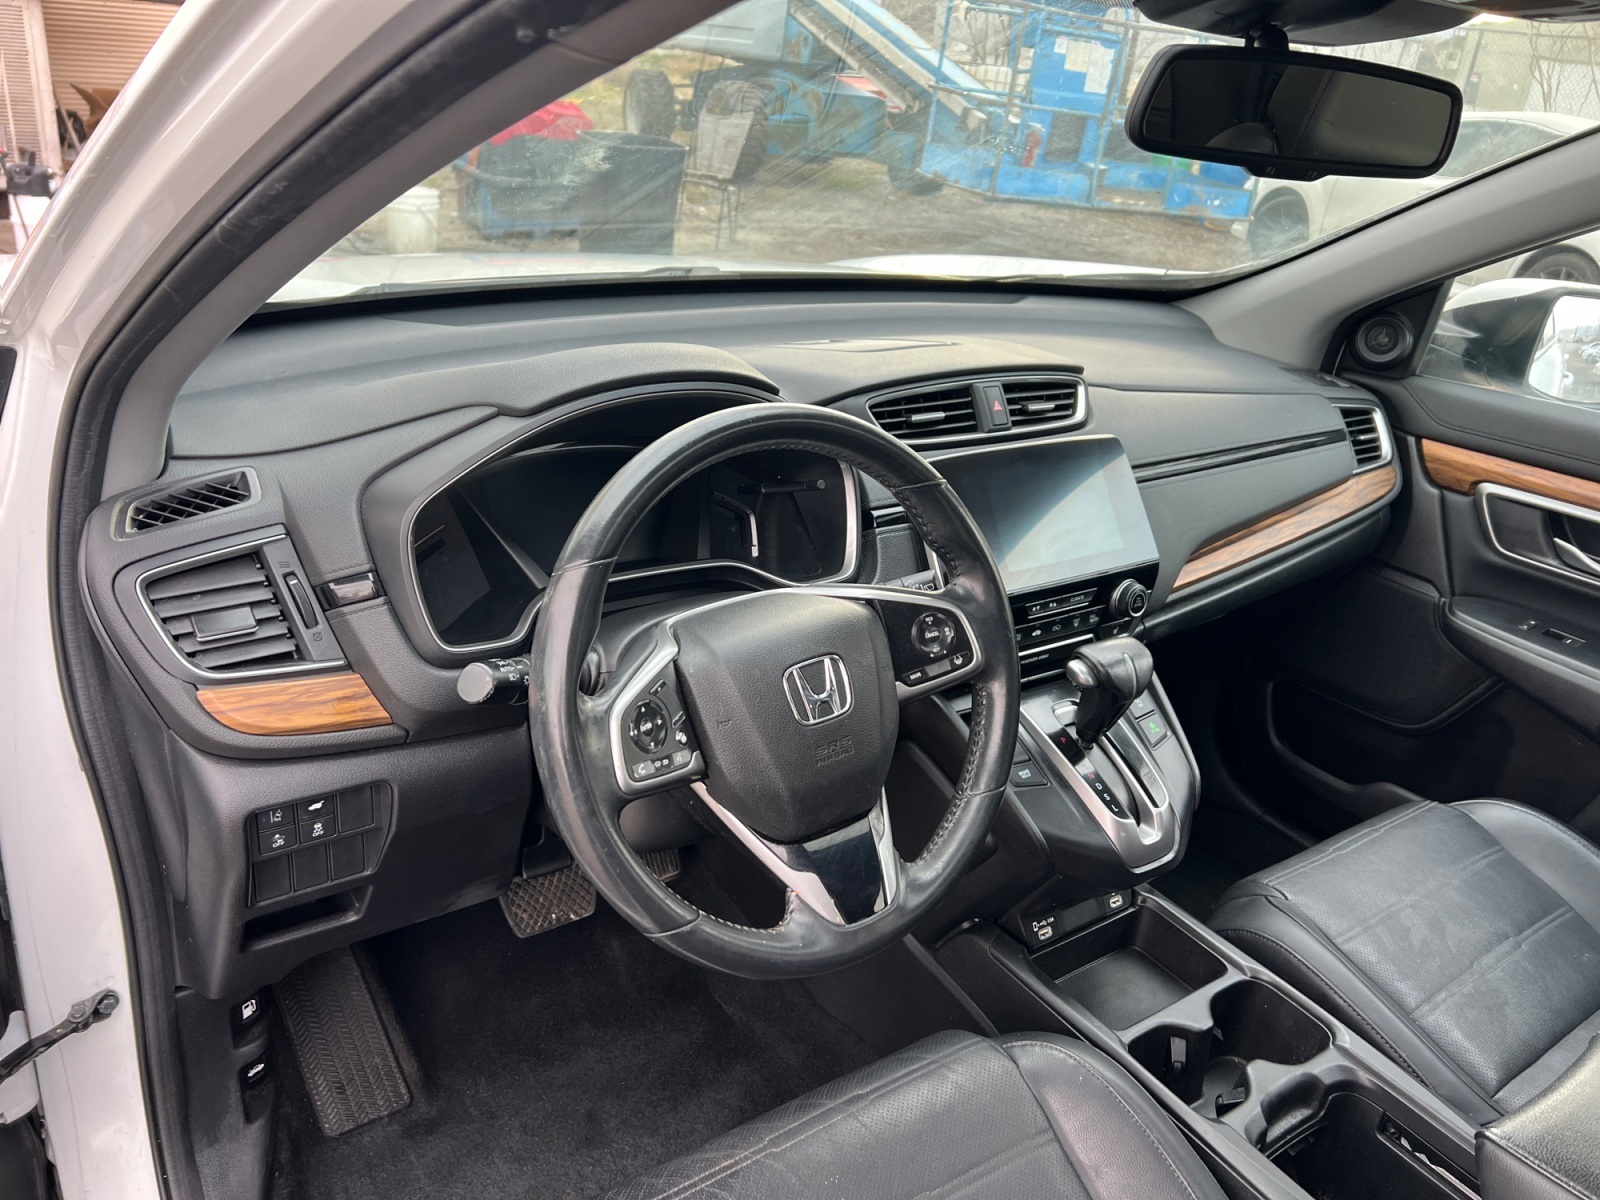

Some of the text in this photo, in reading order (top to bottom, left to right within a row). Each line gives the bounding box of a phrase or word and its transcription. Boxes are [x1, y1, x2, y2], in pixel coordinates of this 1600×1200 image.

[815, 735, 852, 758] SRS
[816, 746, 855, 767] AIRBAG
[1103, 793, 1111, 801] S
[1111, 804, 1119, 812] L
